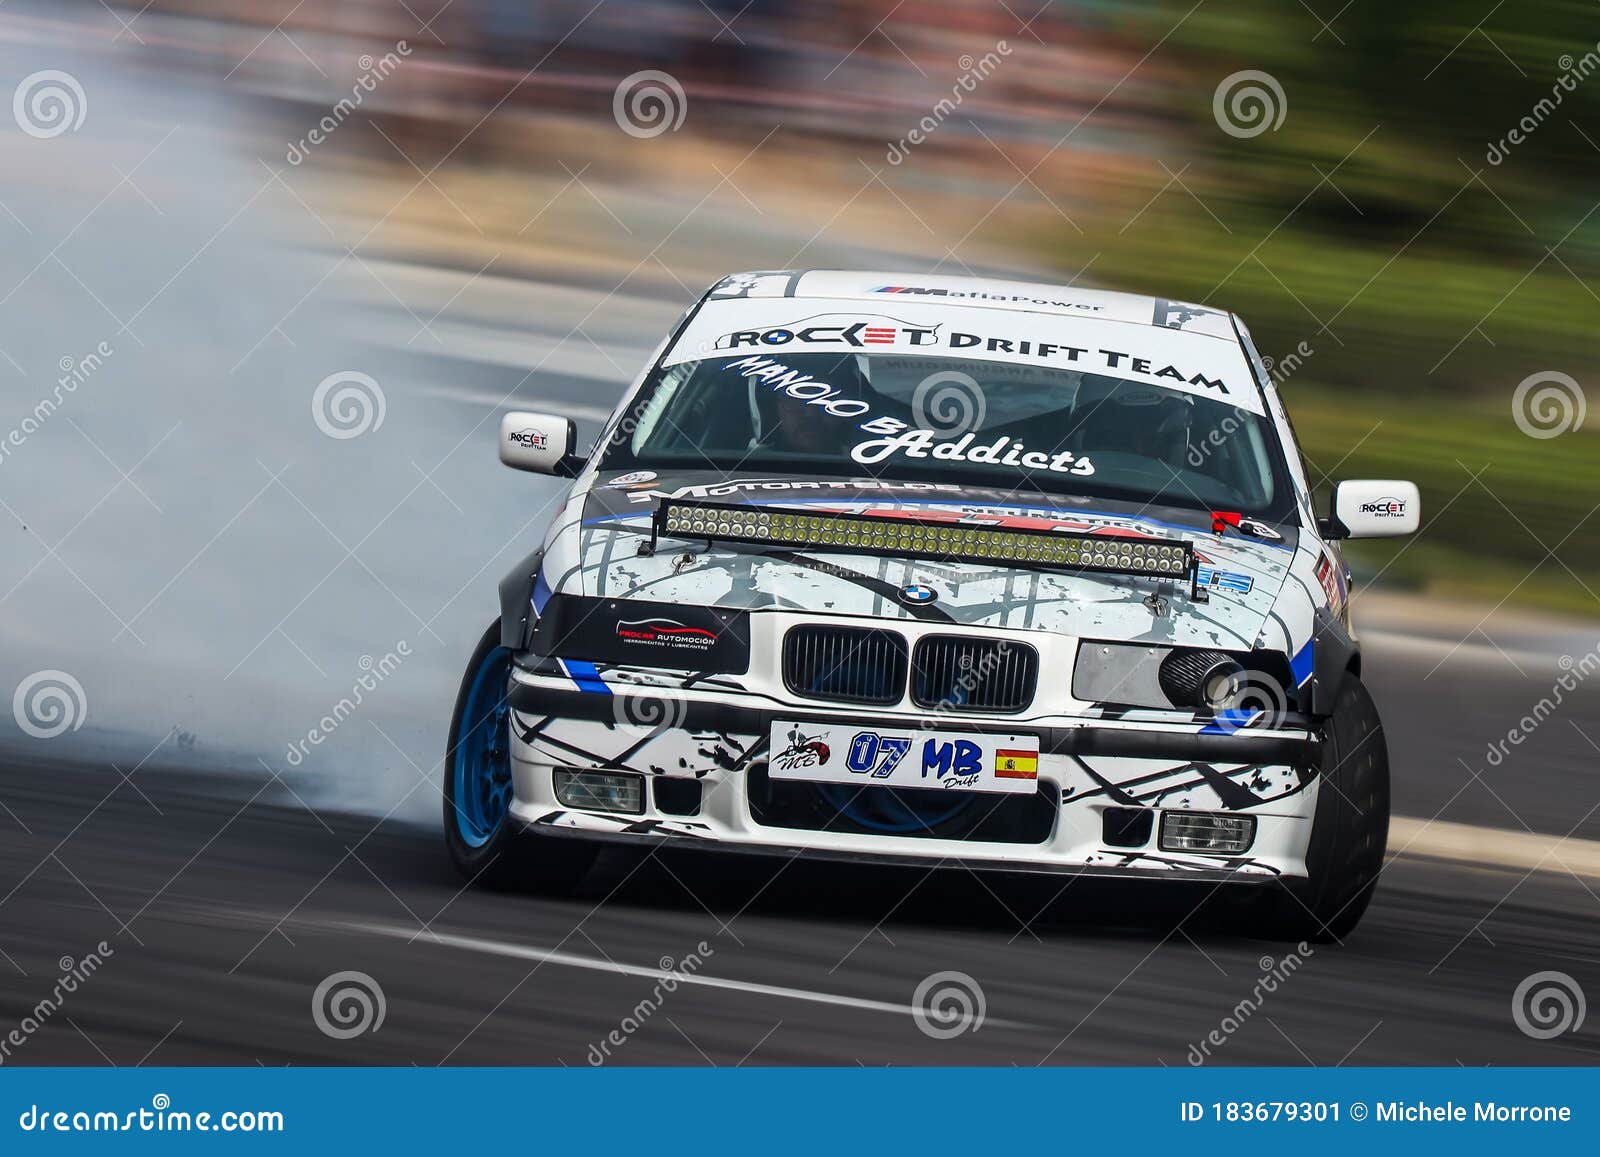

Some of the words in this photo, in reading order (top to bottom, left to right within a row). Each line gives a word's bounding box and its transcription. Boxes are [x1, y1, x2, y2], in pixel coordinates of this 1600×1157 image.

[729, 322, 932, 347] ROCKET
[949, 332, 1089, 361] DRIFT
[1098, 349, 1230, 394] TEAM
[721, 355, 870, 418] MANOLO
[510, 432, 546, 445] ROCKET
[851, 429, 1096, 476] Addicts
[1362, 502, 1405, 514] ROCKET
[846, 731, 912, 778] 07
[921, 738, 983, 780] MB
